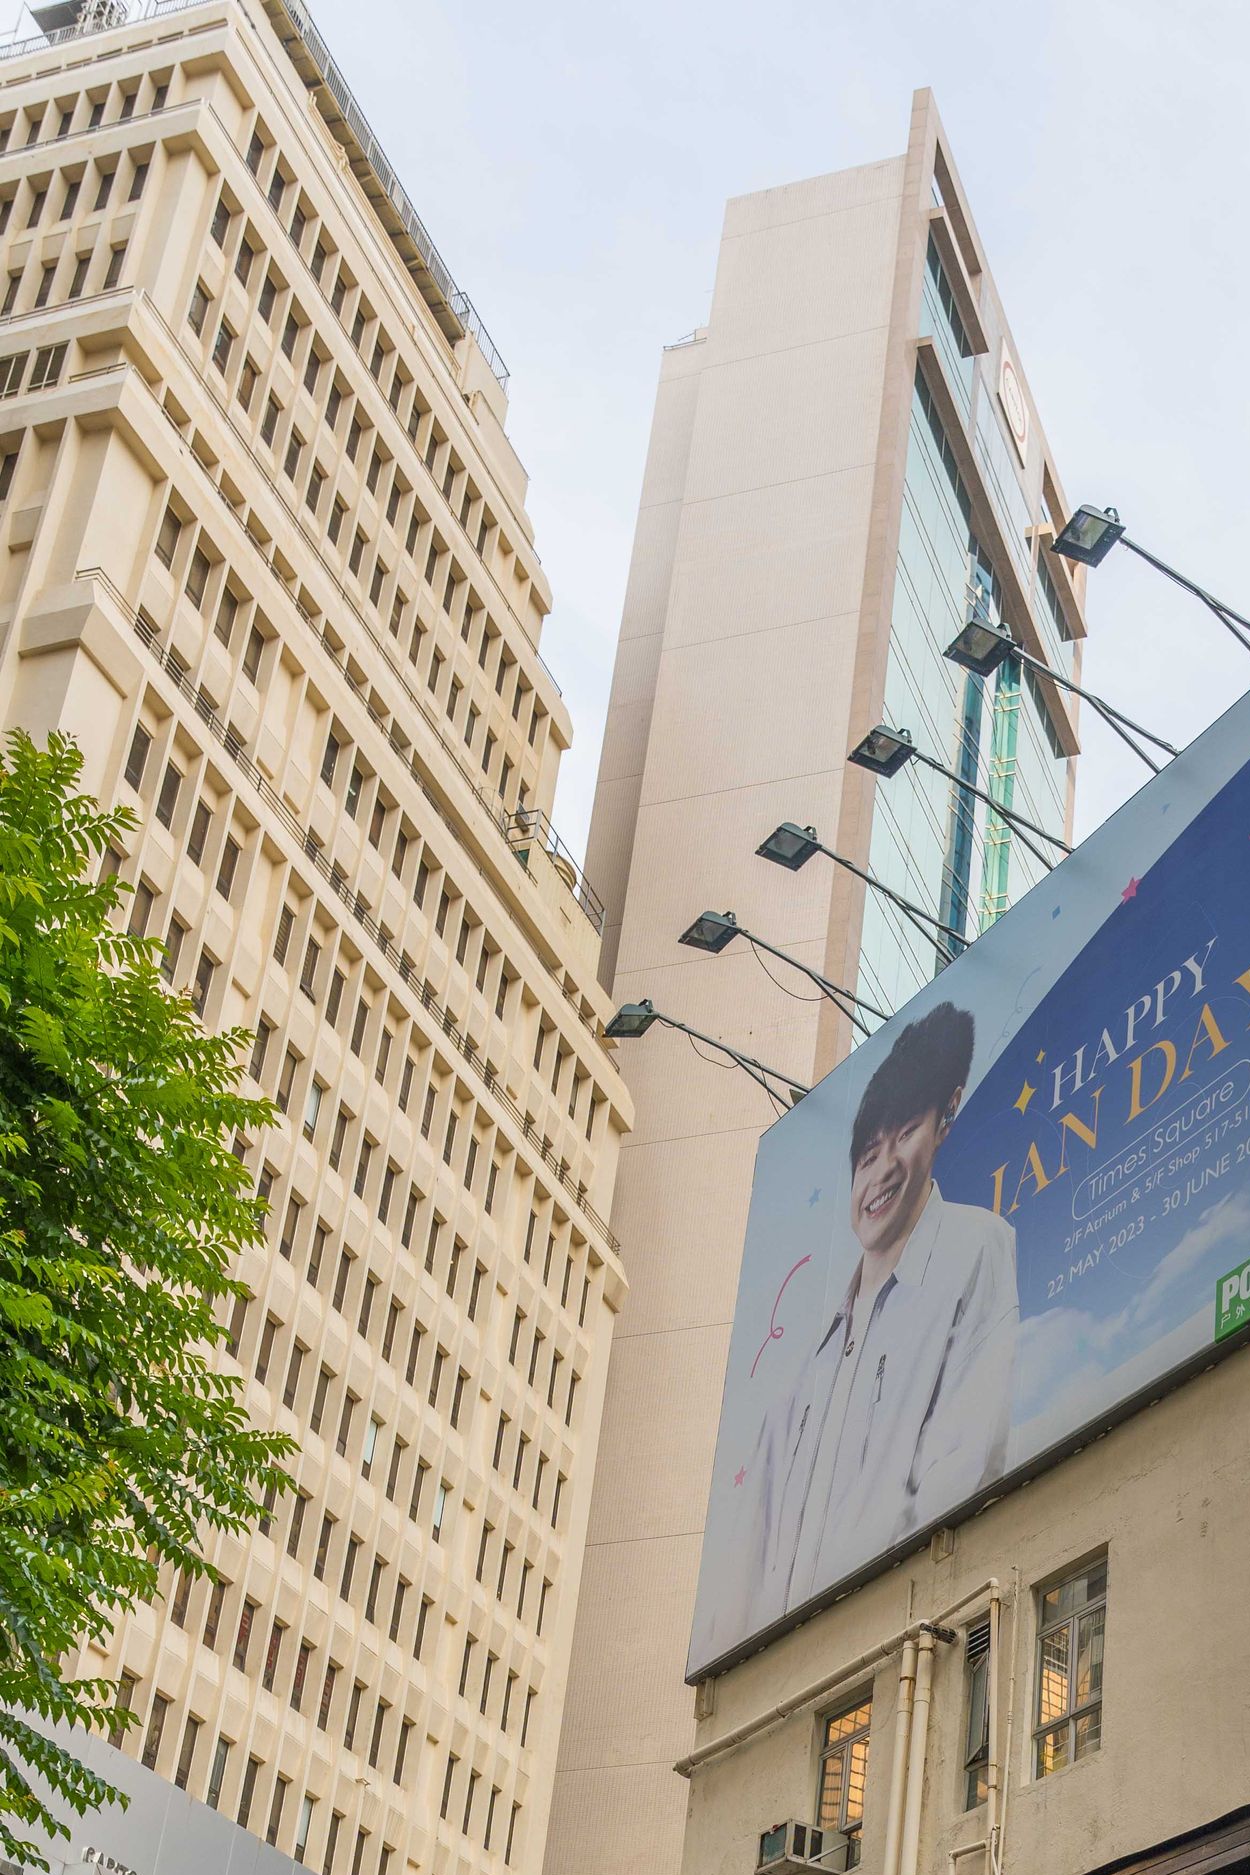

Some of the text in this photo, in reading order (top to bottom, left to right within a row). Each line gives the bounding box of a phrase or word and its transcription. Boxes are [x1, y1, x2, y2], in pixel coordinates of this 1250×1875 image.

[1048, 935, 1219, 1113] HAPPY
[1064, 1226, 1084, 1253] 2/F
[1083, 1198, 1128, 1240] Atrium
[1130, 1187, 1141, 1204] &
[1145, 1168, 1165, 1193] 5/F
[1167, 1146, 1200, 1176] Shop
[1089, 1081, 1235, 1201] Times Square
[1046, 1281, 1064, 1300] 22
[1069, 1244, 1105, 1284] MAY
[1108, 1215, 1146, 1256] 2023
[1161, 1189, 1181, 1217] 30
[1184, 1156, 1231, 1207] JUNE
